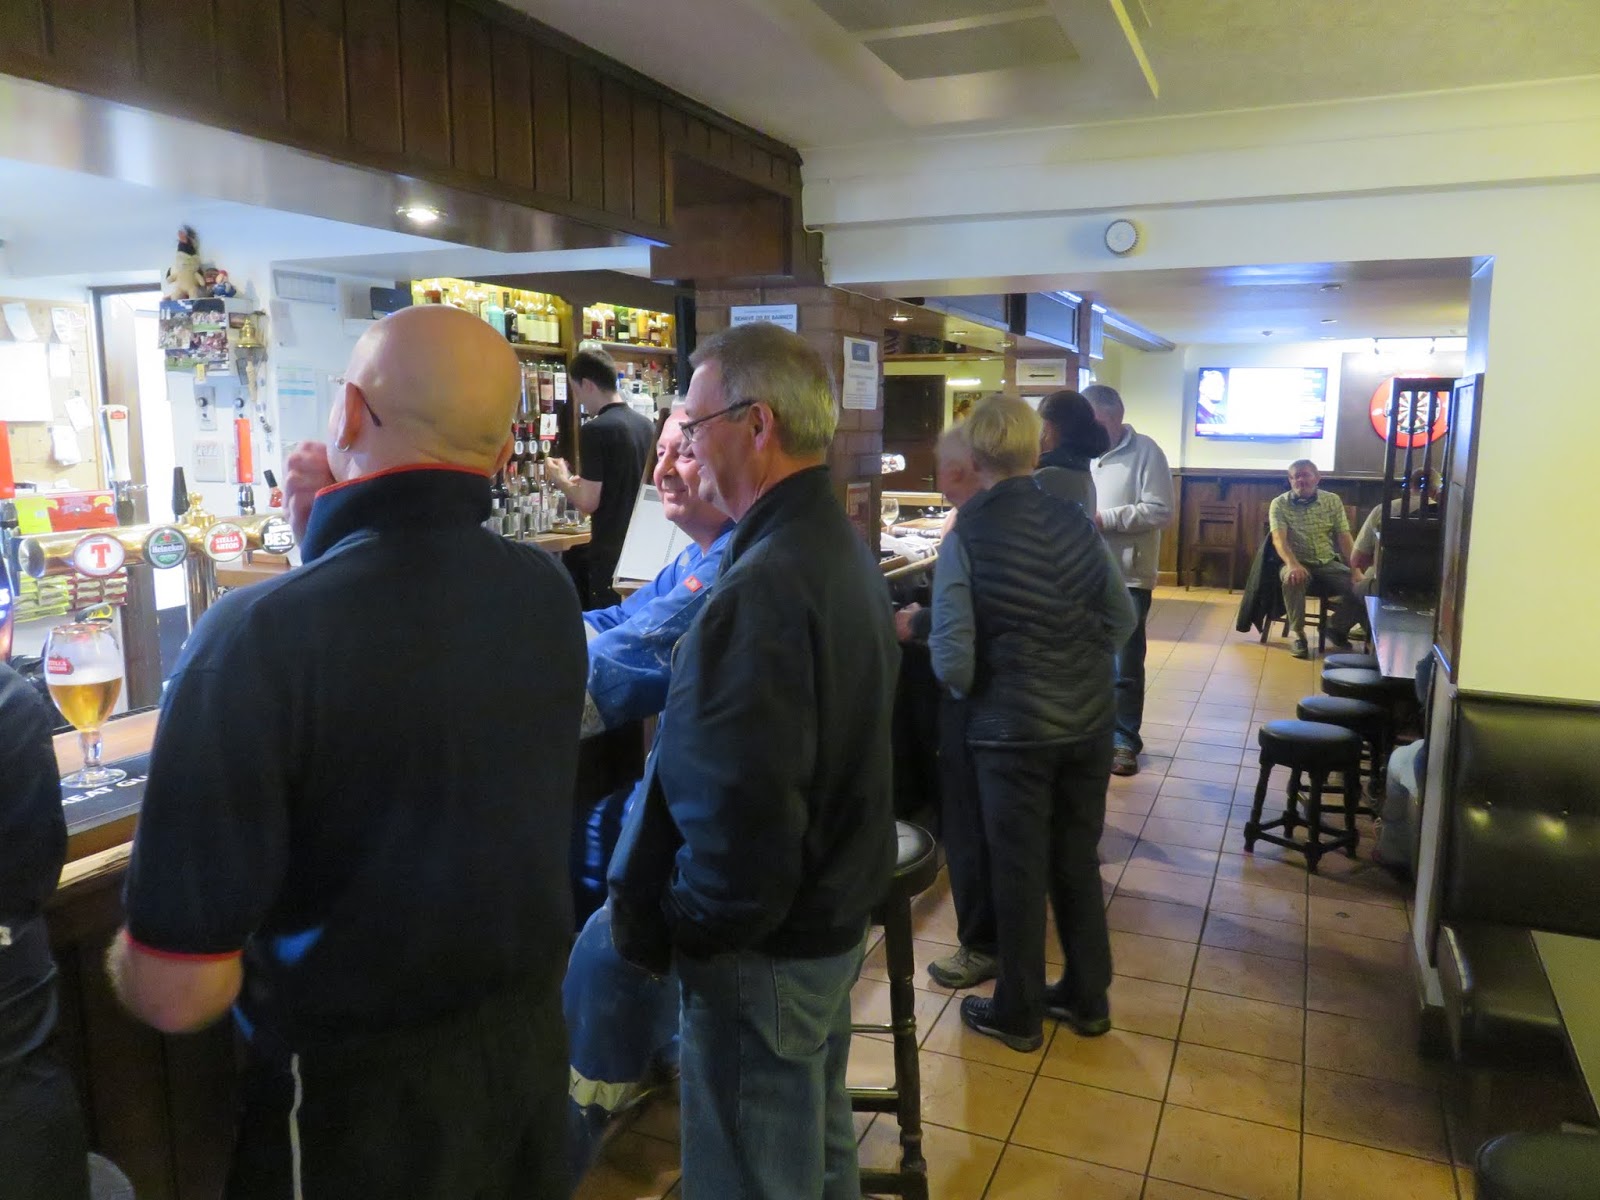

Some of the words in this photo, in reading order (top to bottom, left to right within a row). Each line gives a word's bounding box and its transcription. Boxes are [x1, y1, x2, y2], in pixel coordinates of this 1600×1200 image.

[215, 535, 239, 543] STELLA
[152, 544, 184, 553] Heineken
[216, 542, 240, 551] ARTOIS
